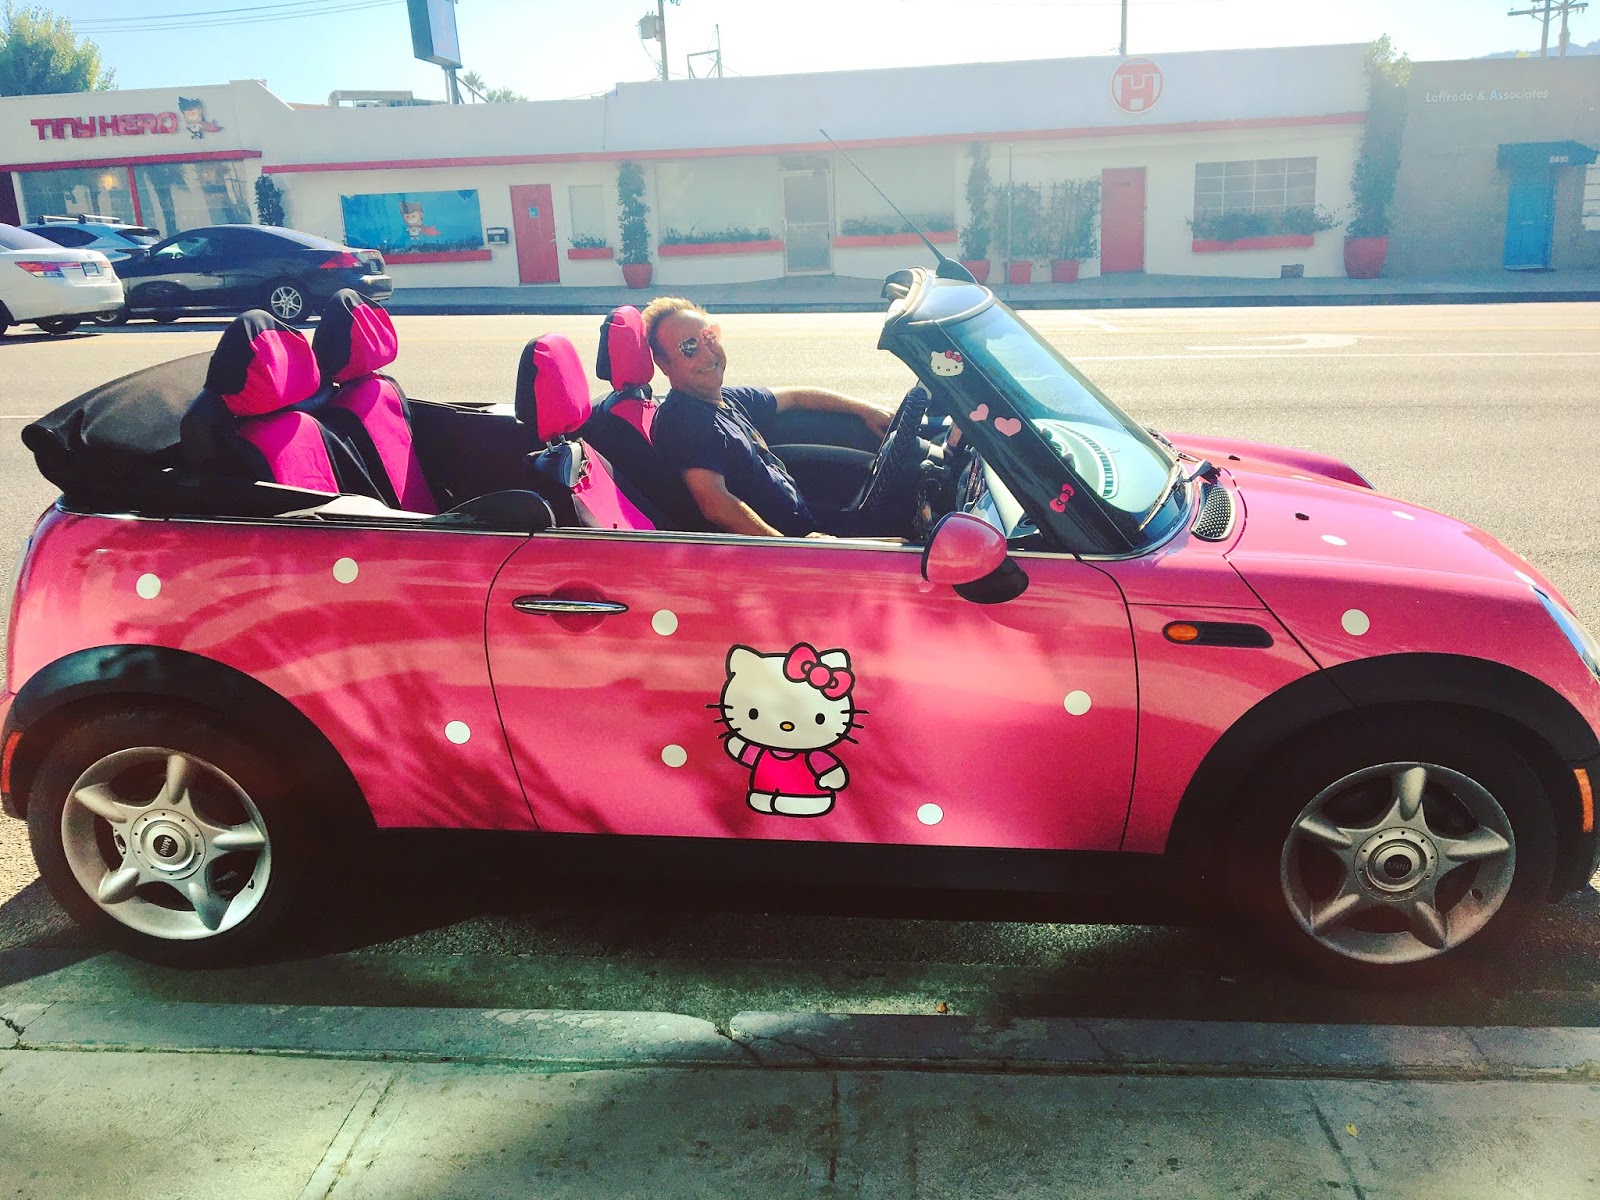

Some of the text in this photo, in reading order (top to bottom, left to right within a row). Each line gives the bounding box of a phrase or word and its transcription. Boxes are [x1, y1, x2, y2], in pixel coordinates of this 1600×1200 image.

[1425, 89, 1549, 103] Loffredo & Associates
[99, 112, 178, 137] HERO
[159, 837, 173, 856] MINI
